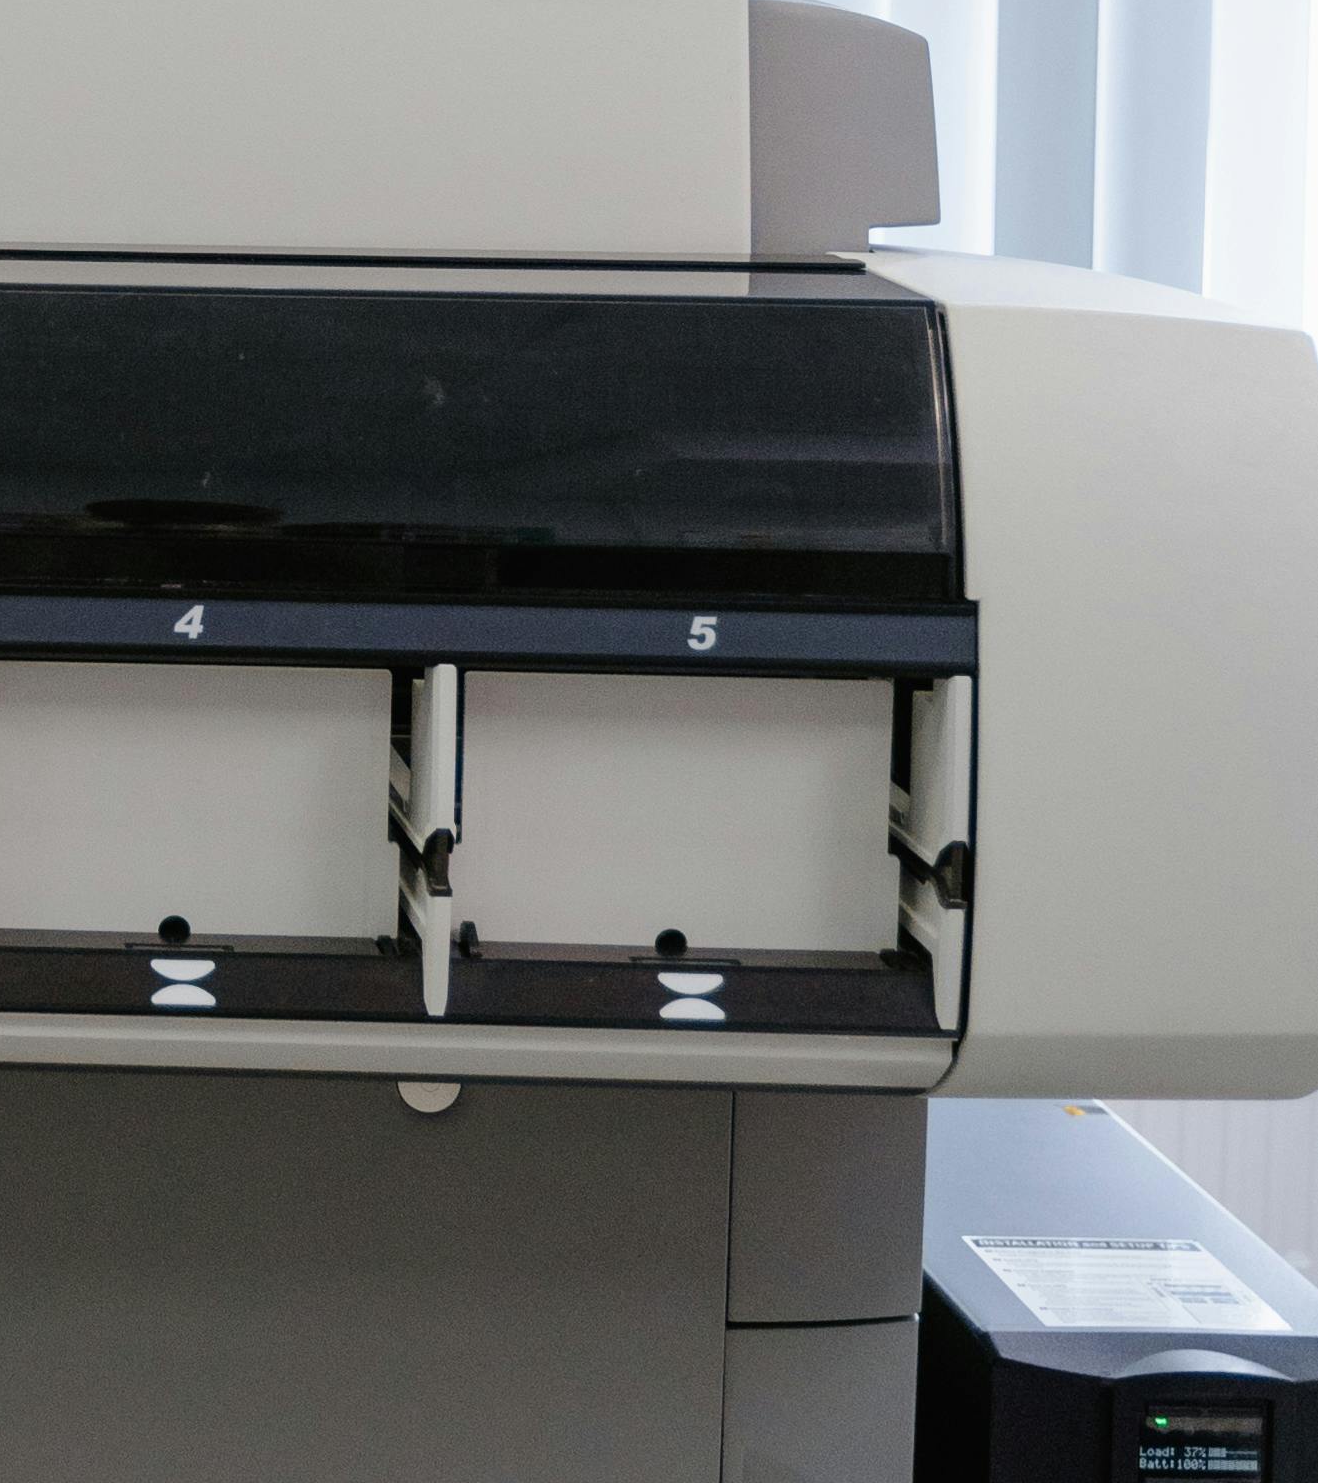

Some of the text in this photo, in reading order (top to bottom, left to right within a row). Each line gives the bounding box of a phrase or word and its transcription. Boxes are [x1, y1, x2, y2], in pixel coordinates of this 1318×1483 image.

[174, 605, 205, 639] 4
[687, 616, 717, 650] 5
[1139, 1446, 1207, 1457] Load: 37%
